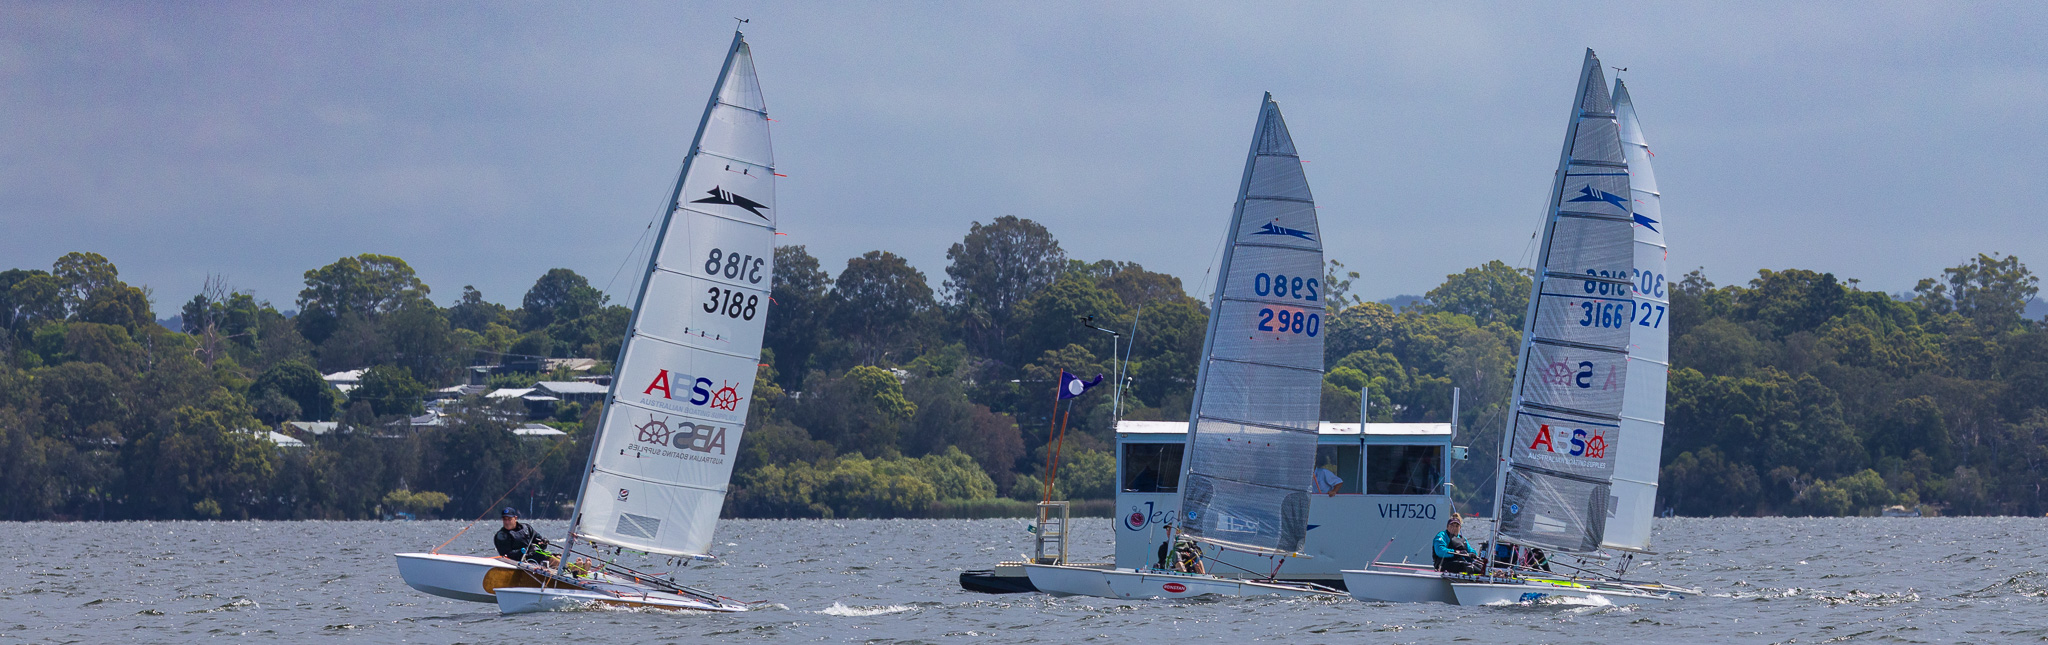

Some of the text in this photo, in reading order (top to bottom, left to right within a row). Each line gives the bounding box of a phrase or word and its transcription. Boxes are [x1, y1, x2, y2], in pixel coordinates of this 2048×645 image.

[703, 287, 758, 321] 3188
[1580, 302, 1624, 329] 3166
[1258, 308, 1319, 337] 2980
[643, 369, 713, 406] ABS
[640, 398, 683, 413] AUSTRALIAN
[684, 406, 710, 418] BOATING
[1529, 424, 1587, 456] ABS
[1378, 503, 1437, 520] VH752Q
